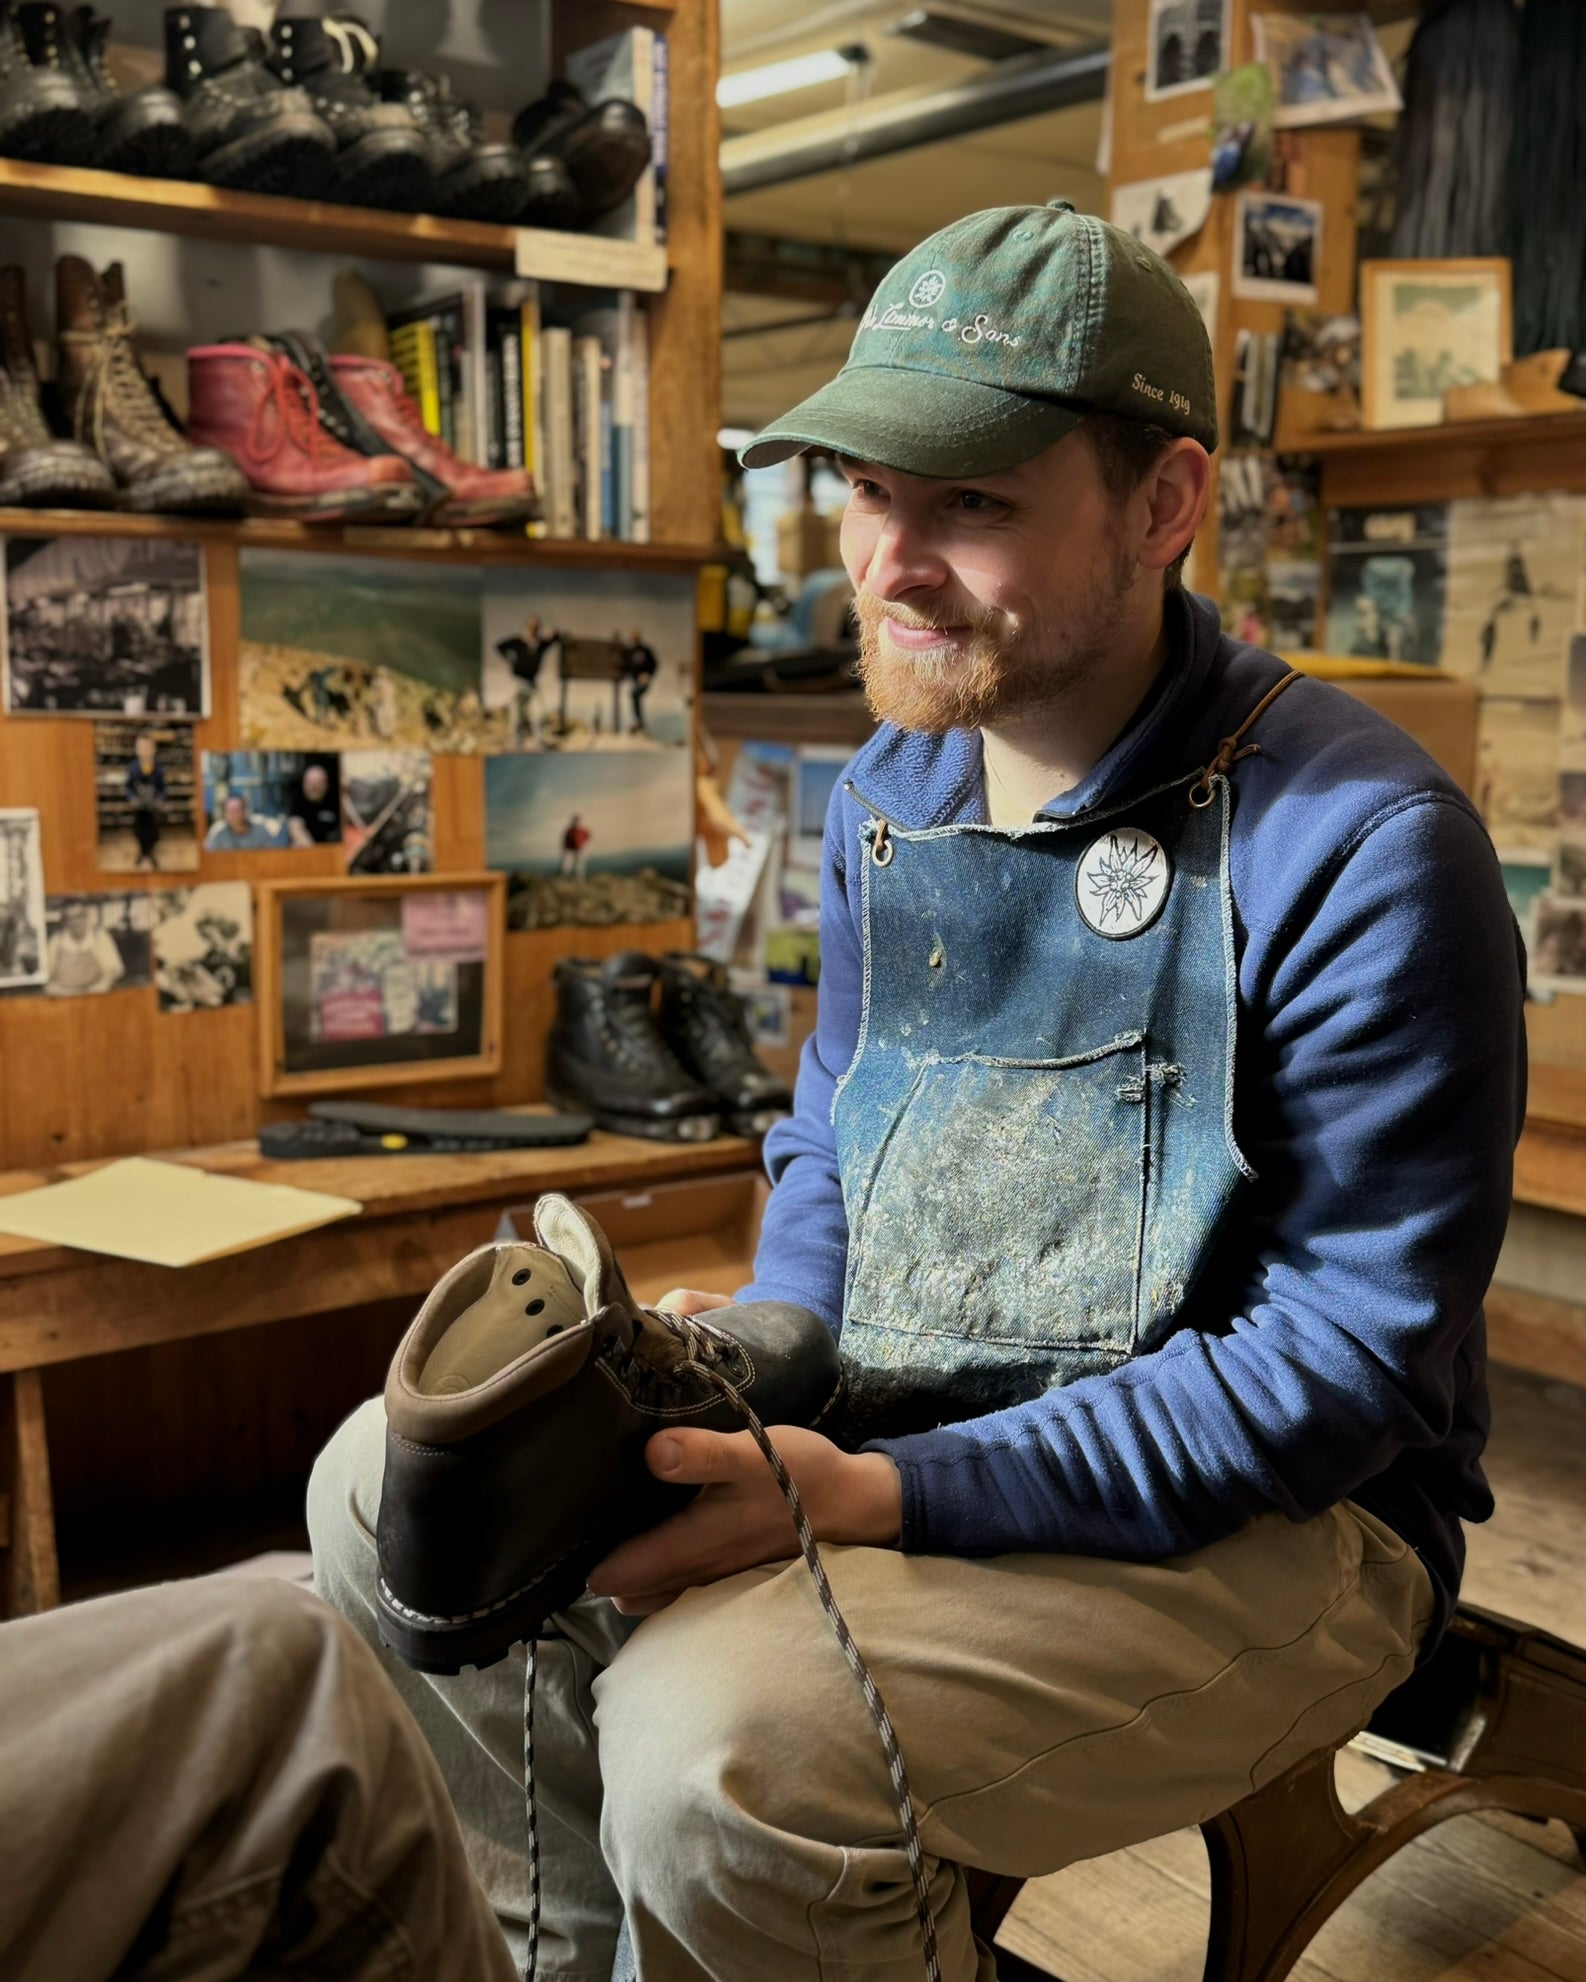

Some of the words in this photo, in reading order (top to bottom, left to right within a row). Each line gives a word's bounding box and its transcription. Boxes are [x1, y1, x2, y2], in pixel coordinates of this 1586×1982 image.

[962, 314, 1021, 347] Sons
[1132, 373, 1164, 401] Since
[1169, 390, 1191, 415] 1919
